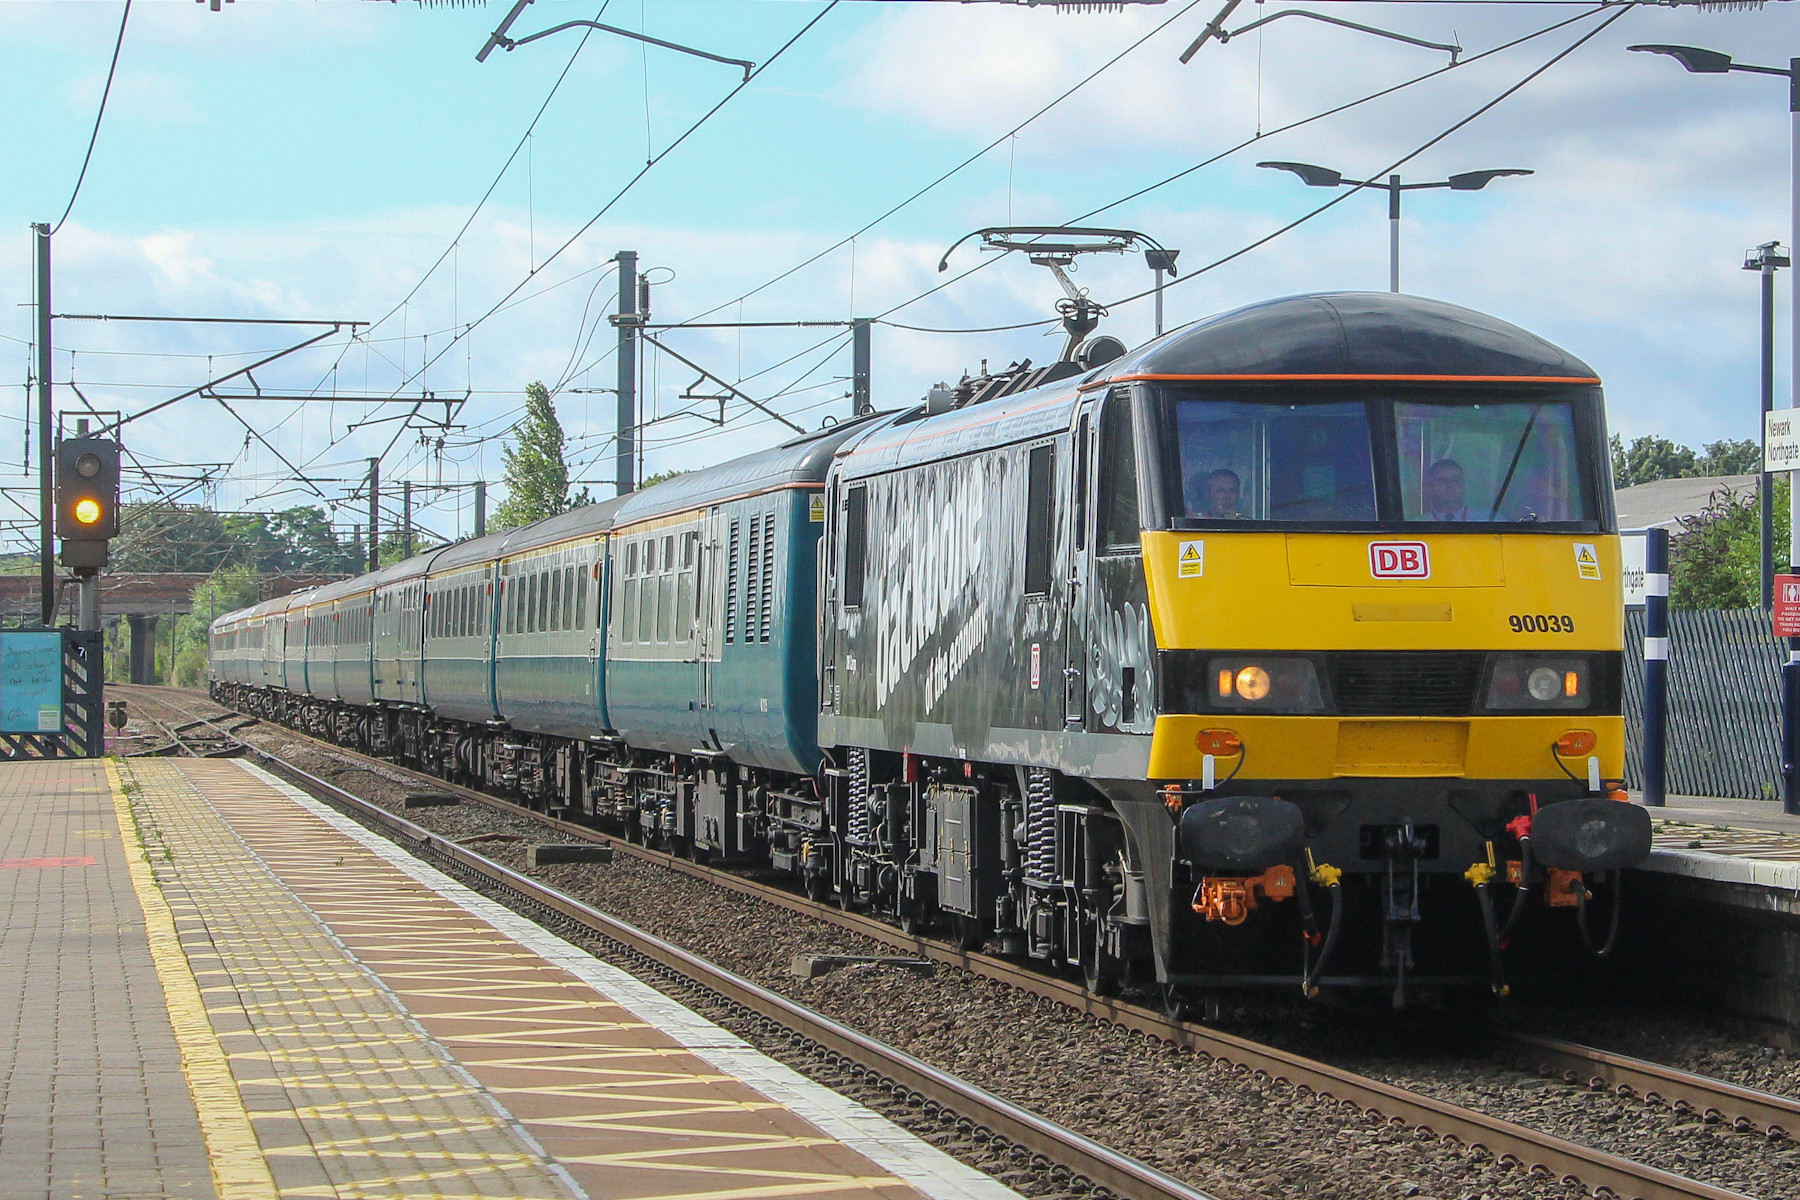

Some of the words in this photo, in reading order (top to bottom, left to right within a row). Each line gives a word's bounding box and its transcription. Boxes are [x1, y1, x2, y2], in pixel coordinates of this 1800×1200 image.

[1768, 417, 1791, 438] Newark
[1768, 441, 1799, 465] Northgate
[1379, 550, 1420, 571] DB
[877, 456, 982, 712] backbone
[1508, 614, 1575, 633] 90039
[925, 656, 934, 716] of
[934, 646, 948, 703] the
